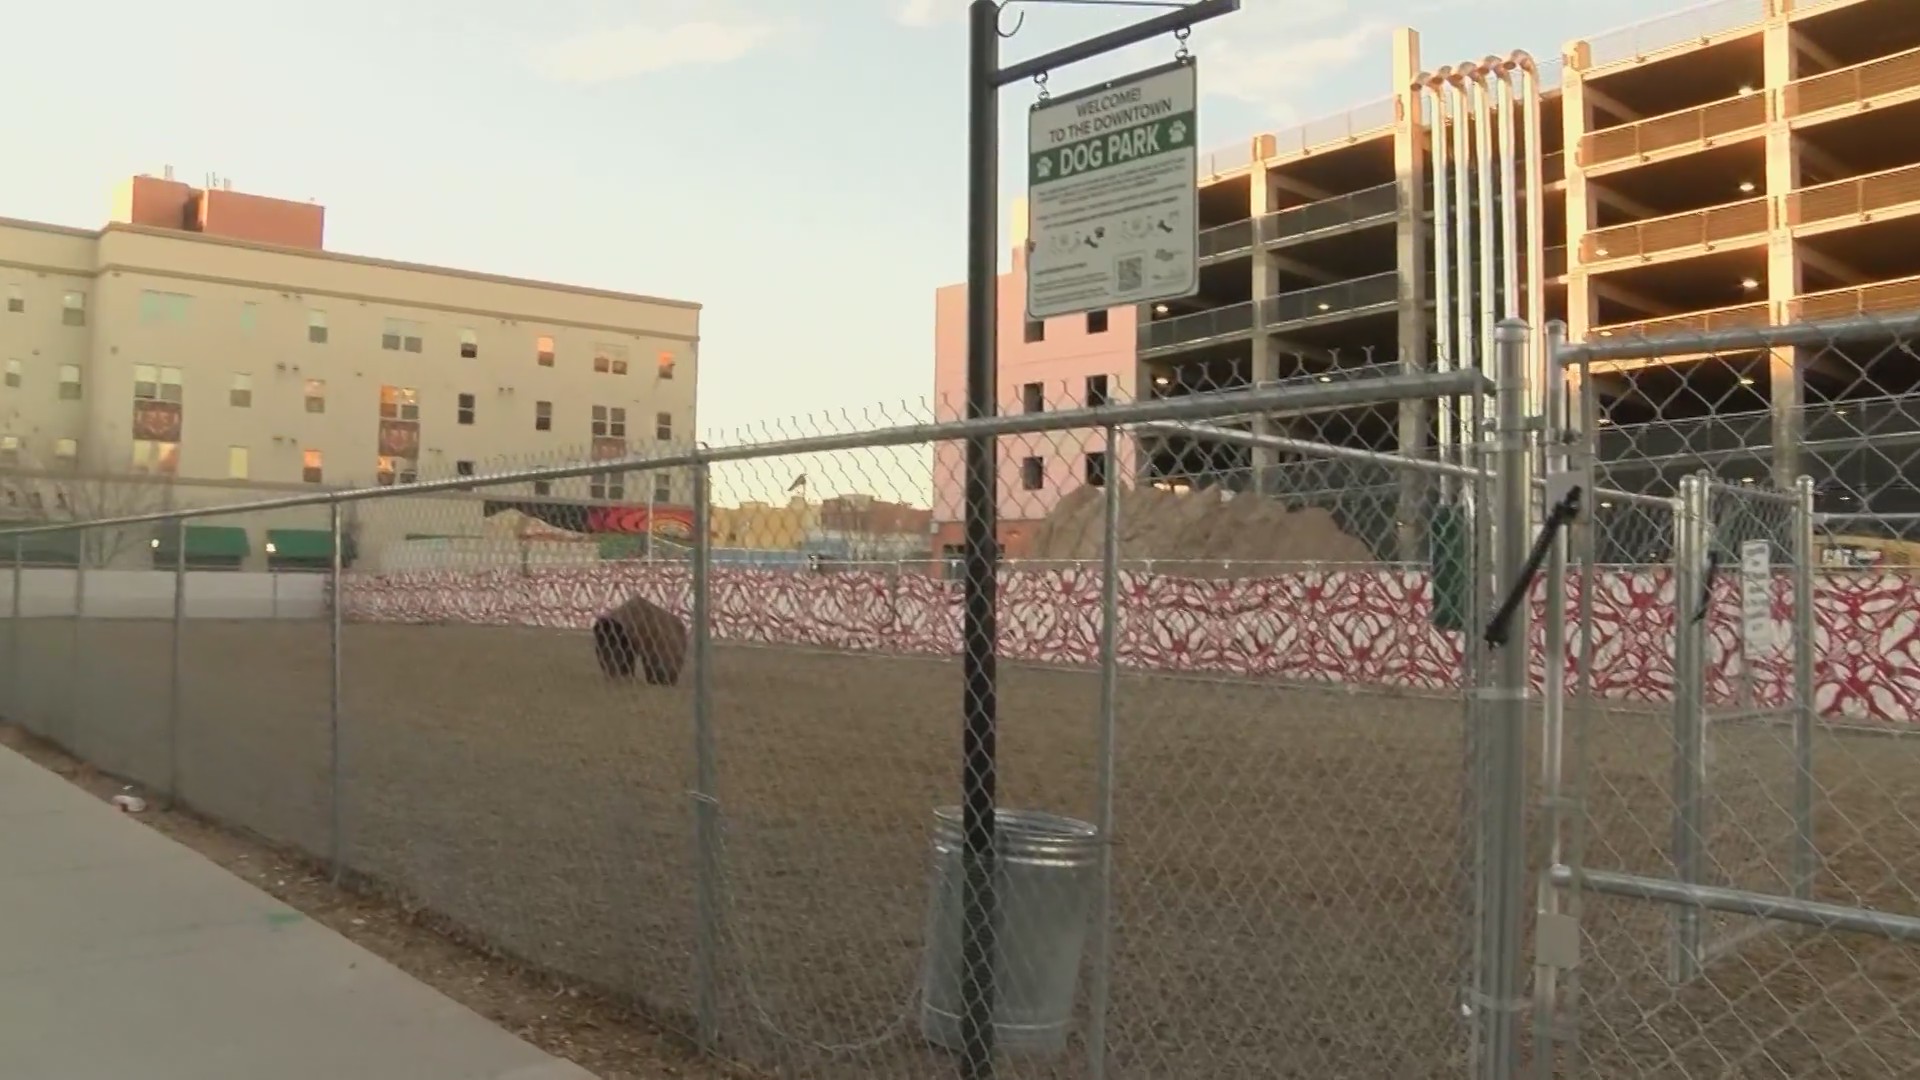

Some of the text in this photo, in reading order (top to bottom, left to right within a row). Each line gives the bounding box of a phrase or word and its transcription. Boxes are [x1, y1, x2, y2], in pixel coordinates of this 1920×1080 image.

[1049, 97, 1173, 143] TO THE DOWNTOWN
[1075, 88, 1142, 117] WELCOME!
[1059, 123, 1161, 176] DOG PARK
